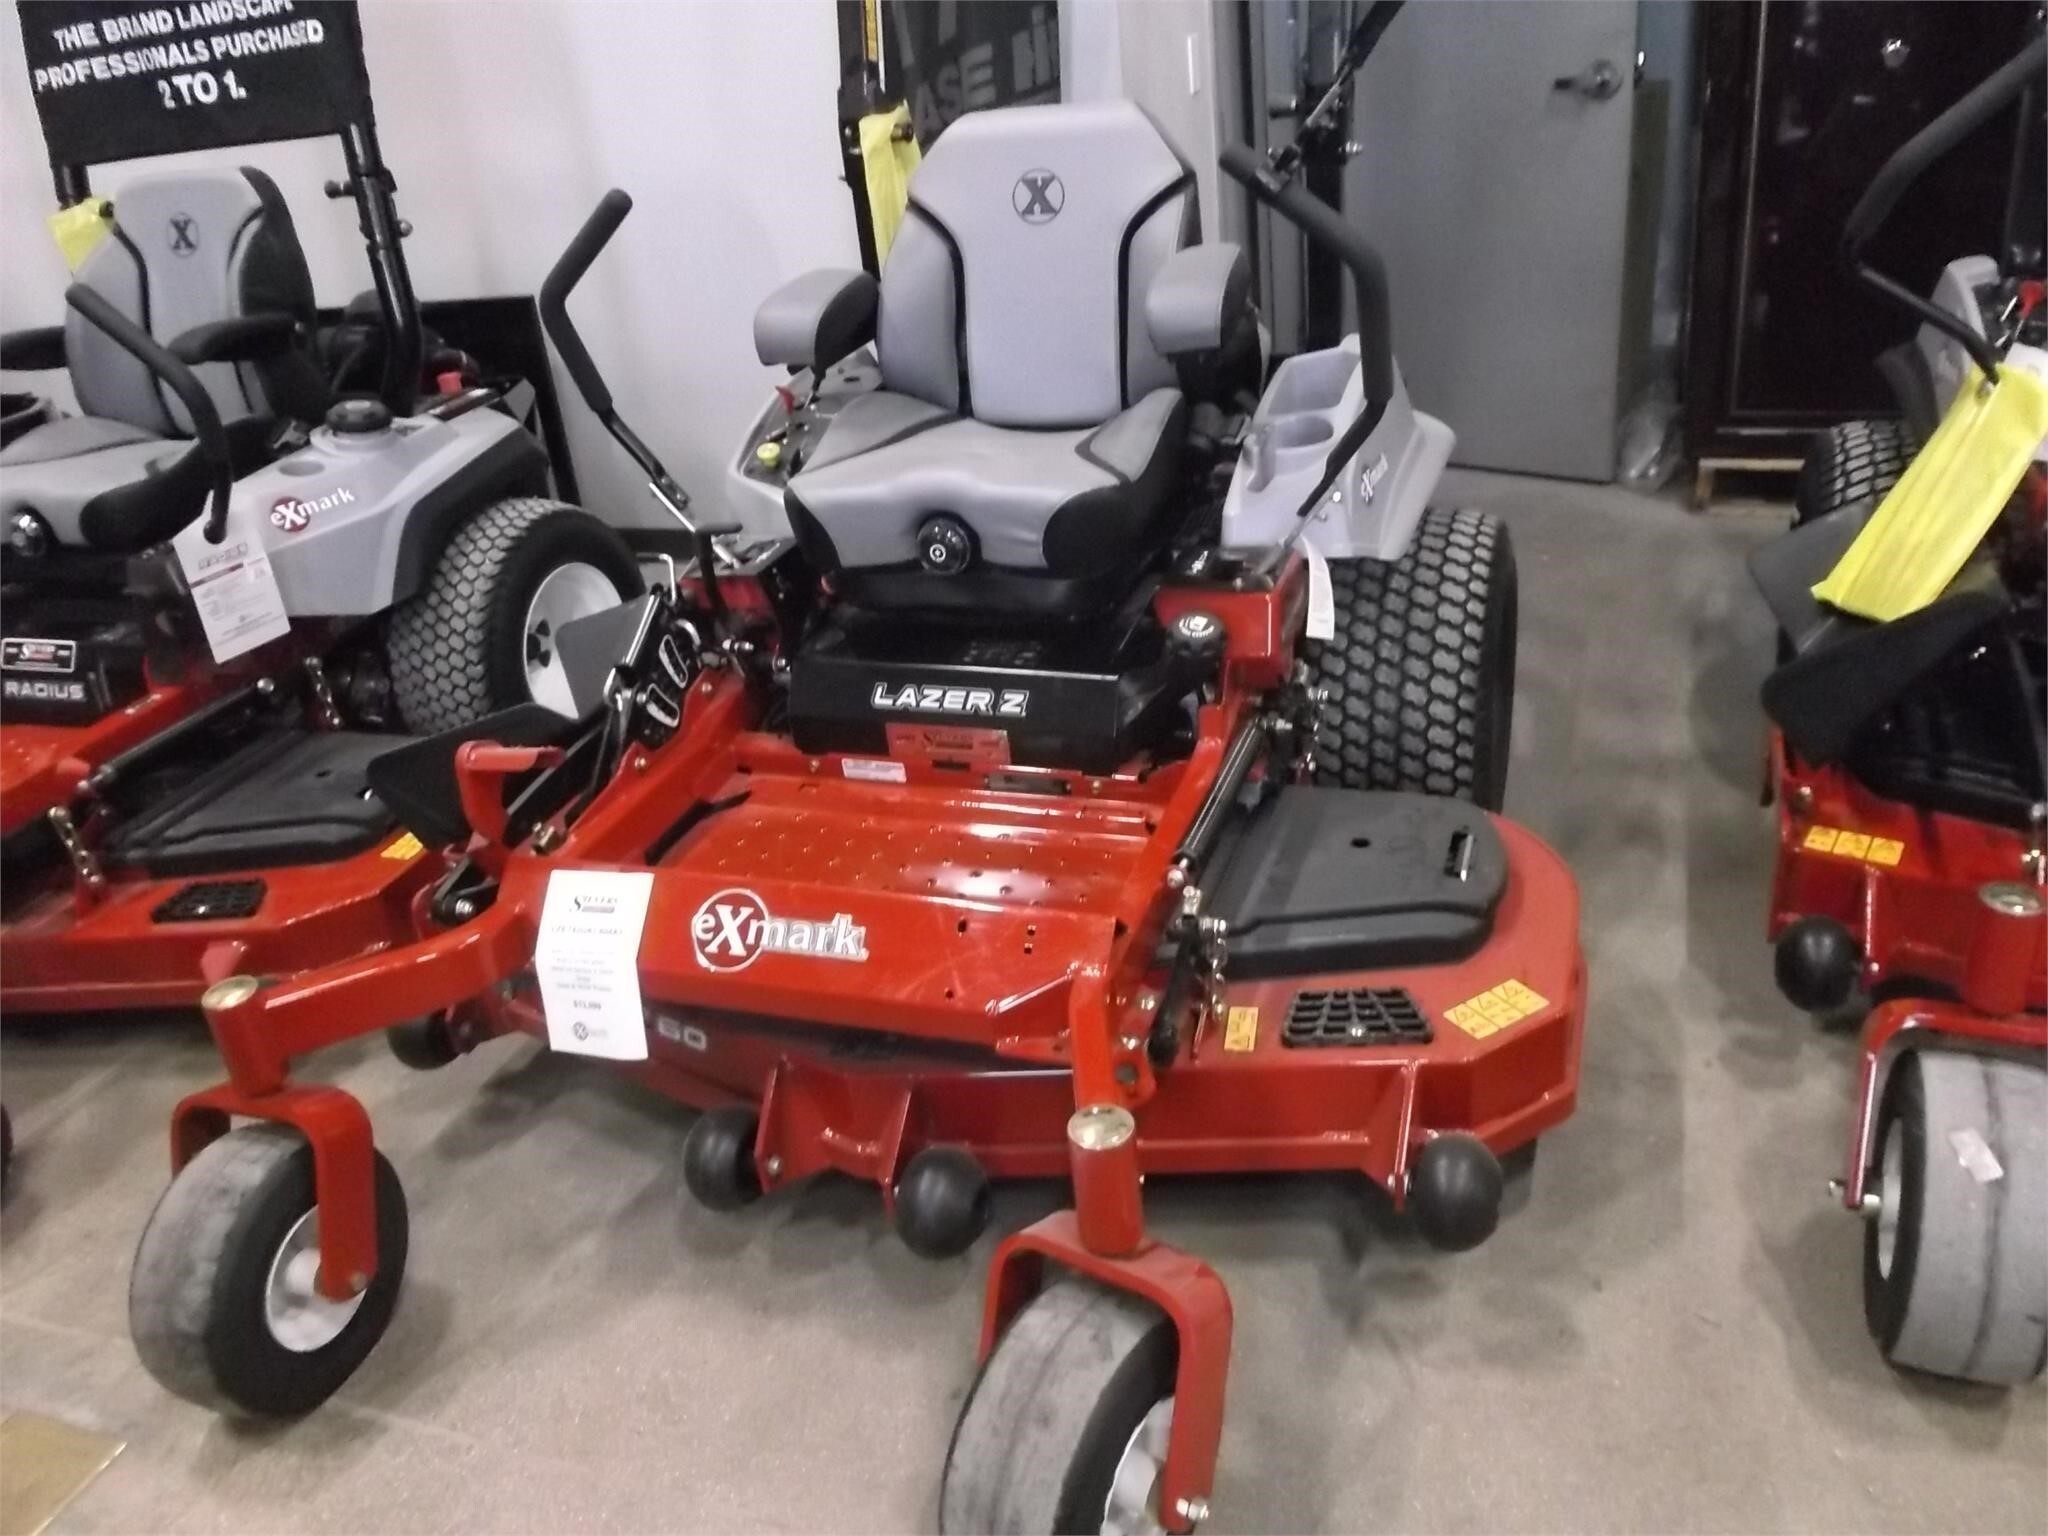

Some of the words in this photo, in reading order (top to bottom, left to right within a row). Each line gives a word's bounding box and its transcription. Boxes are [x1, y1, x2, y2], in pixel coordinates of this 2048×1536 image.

[53, 22, 100, 52] THE
[102, 9, 174, 44] BRAND
[34, 38, 211, 92] PROFESSIONALS
[210, 19, 324, 60] PURCHASED
[157, 79, 176, 108] 2
[172, 71, 218, 106] TO
[223, 68, 247, 99] 1.
[270, 487, 355, 530] eXmark
[4, 681, 84, 699] RADIUS
[872, 683, 993, 714] LAZER
[999, 690, 1029, 717] Z
